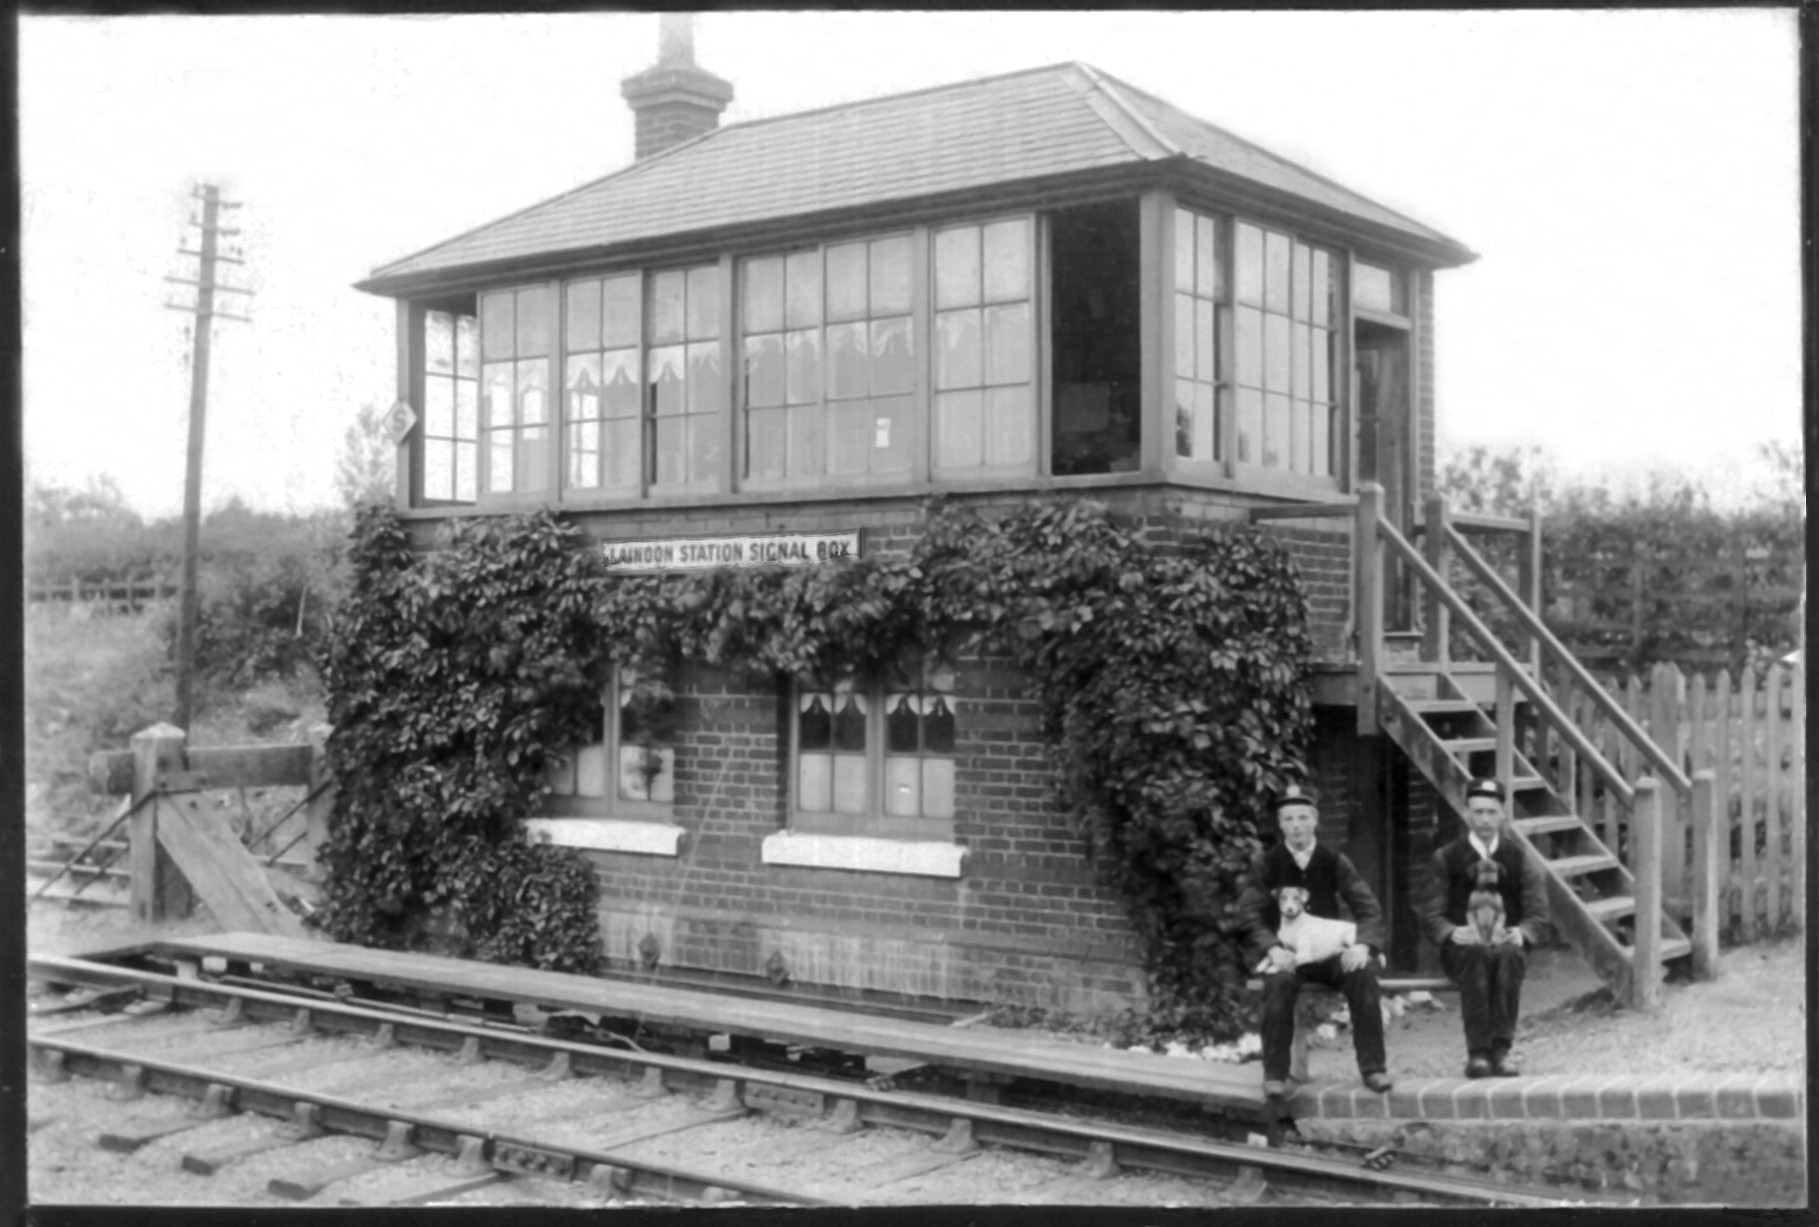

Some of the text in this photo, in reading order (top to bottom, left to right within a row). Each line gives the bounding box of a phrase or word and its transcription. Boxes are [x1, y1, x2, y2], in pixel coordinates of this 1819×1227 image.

[392, 409, 407, 433] S
[679, 543, 743, 563] STATION
[749, 541, 810, 561] SIGNAL
[817, 540, 850, 561] BOX
